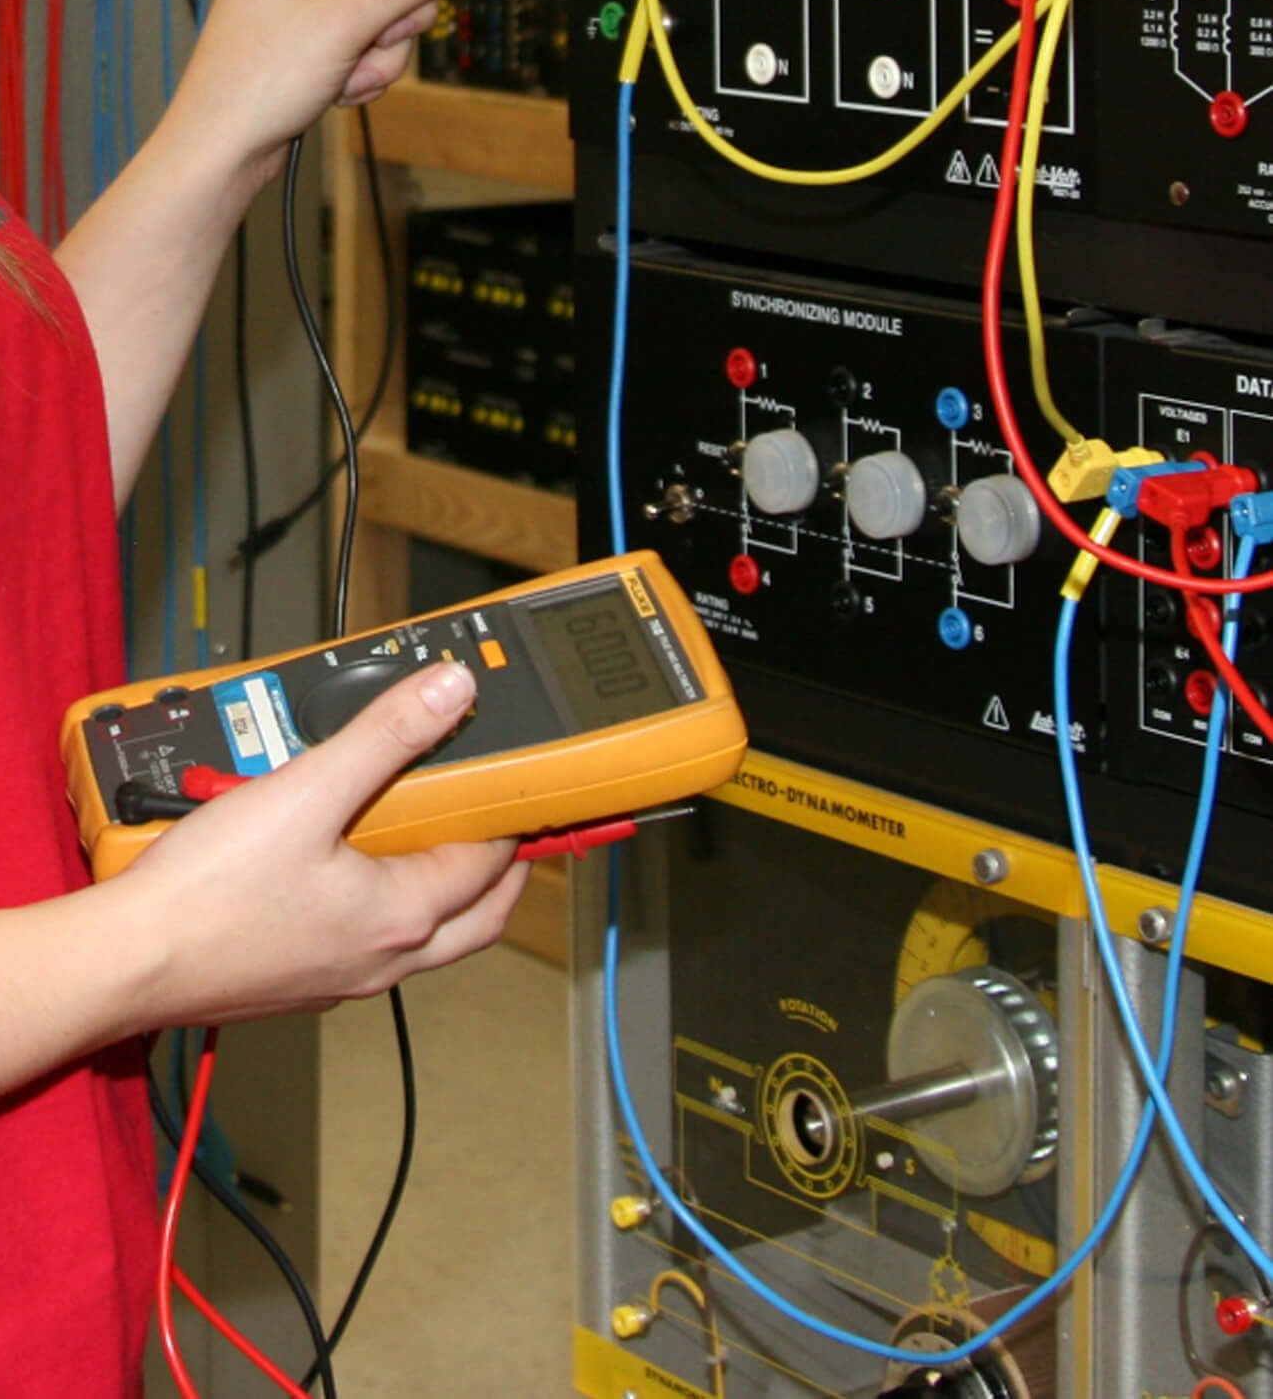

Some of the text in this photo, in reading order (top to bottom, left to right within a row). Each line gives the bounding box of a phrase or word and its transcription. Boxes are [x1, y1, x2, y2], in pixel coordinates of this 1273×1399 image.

[775, 58, 789, 76] N
[901, 71, 914, 90] N
[732, 291, 902, 335] SYNCHRONIZING MODULE
[760, 362, 767, 378] 1
[862, 382, 872, 400] 2
[1235, 373, 1273, 400] DAT
[973, 403, 983, 421] 3
[1176, 428, 1191, 443] E1
[761, 571, 771, 586] 4
[625, 576, 654, 614] FLUKE
[864, 596, 875, 614] 5
[973, 624, 985, 642] 6
[730, 771, 907, 839] ECTRO-DYNAMOMETER
